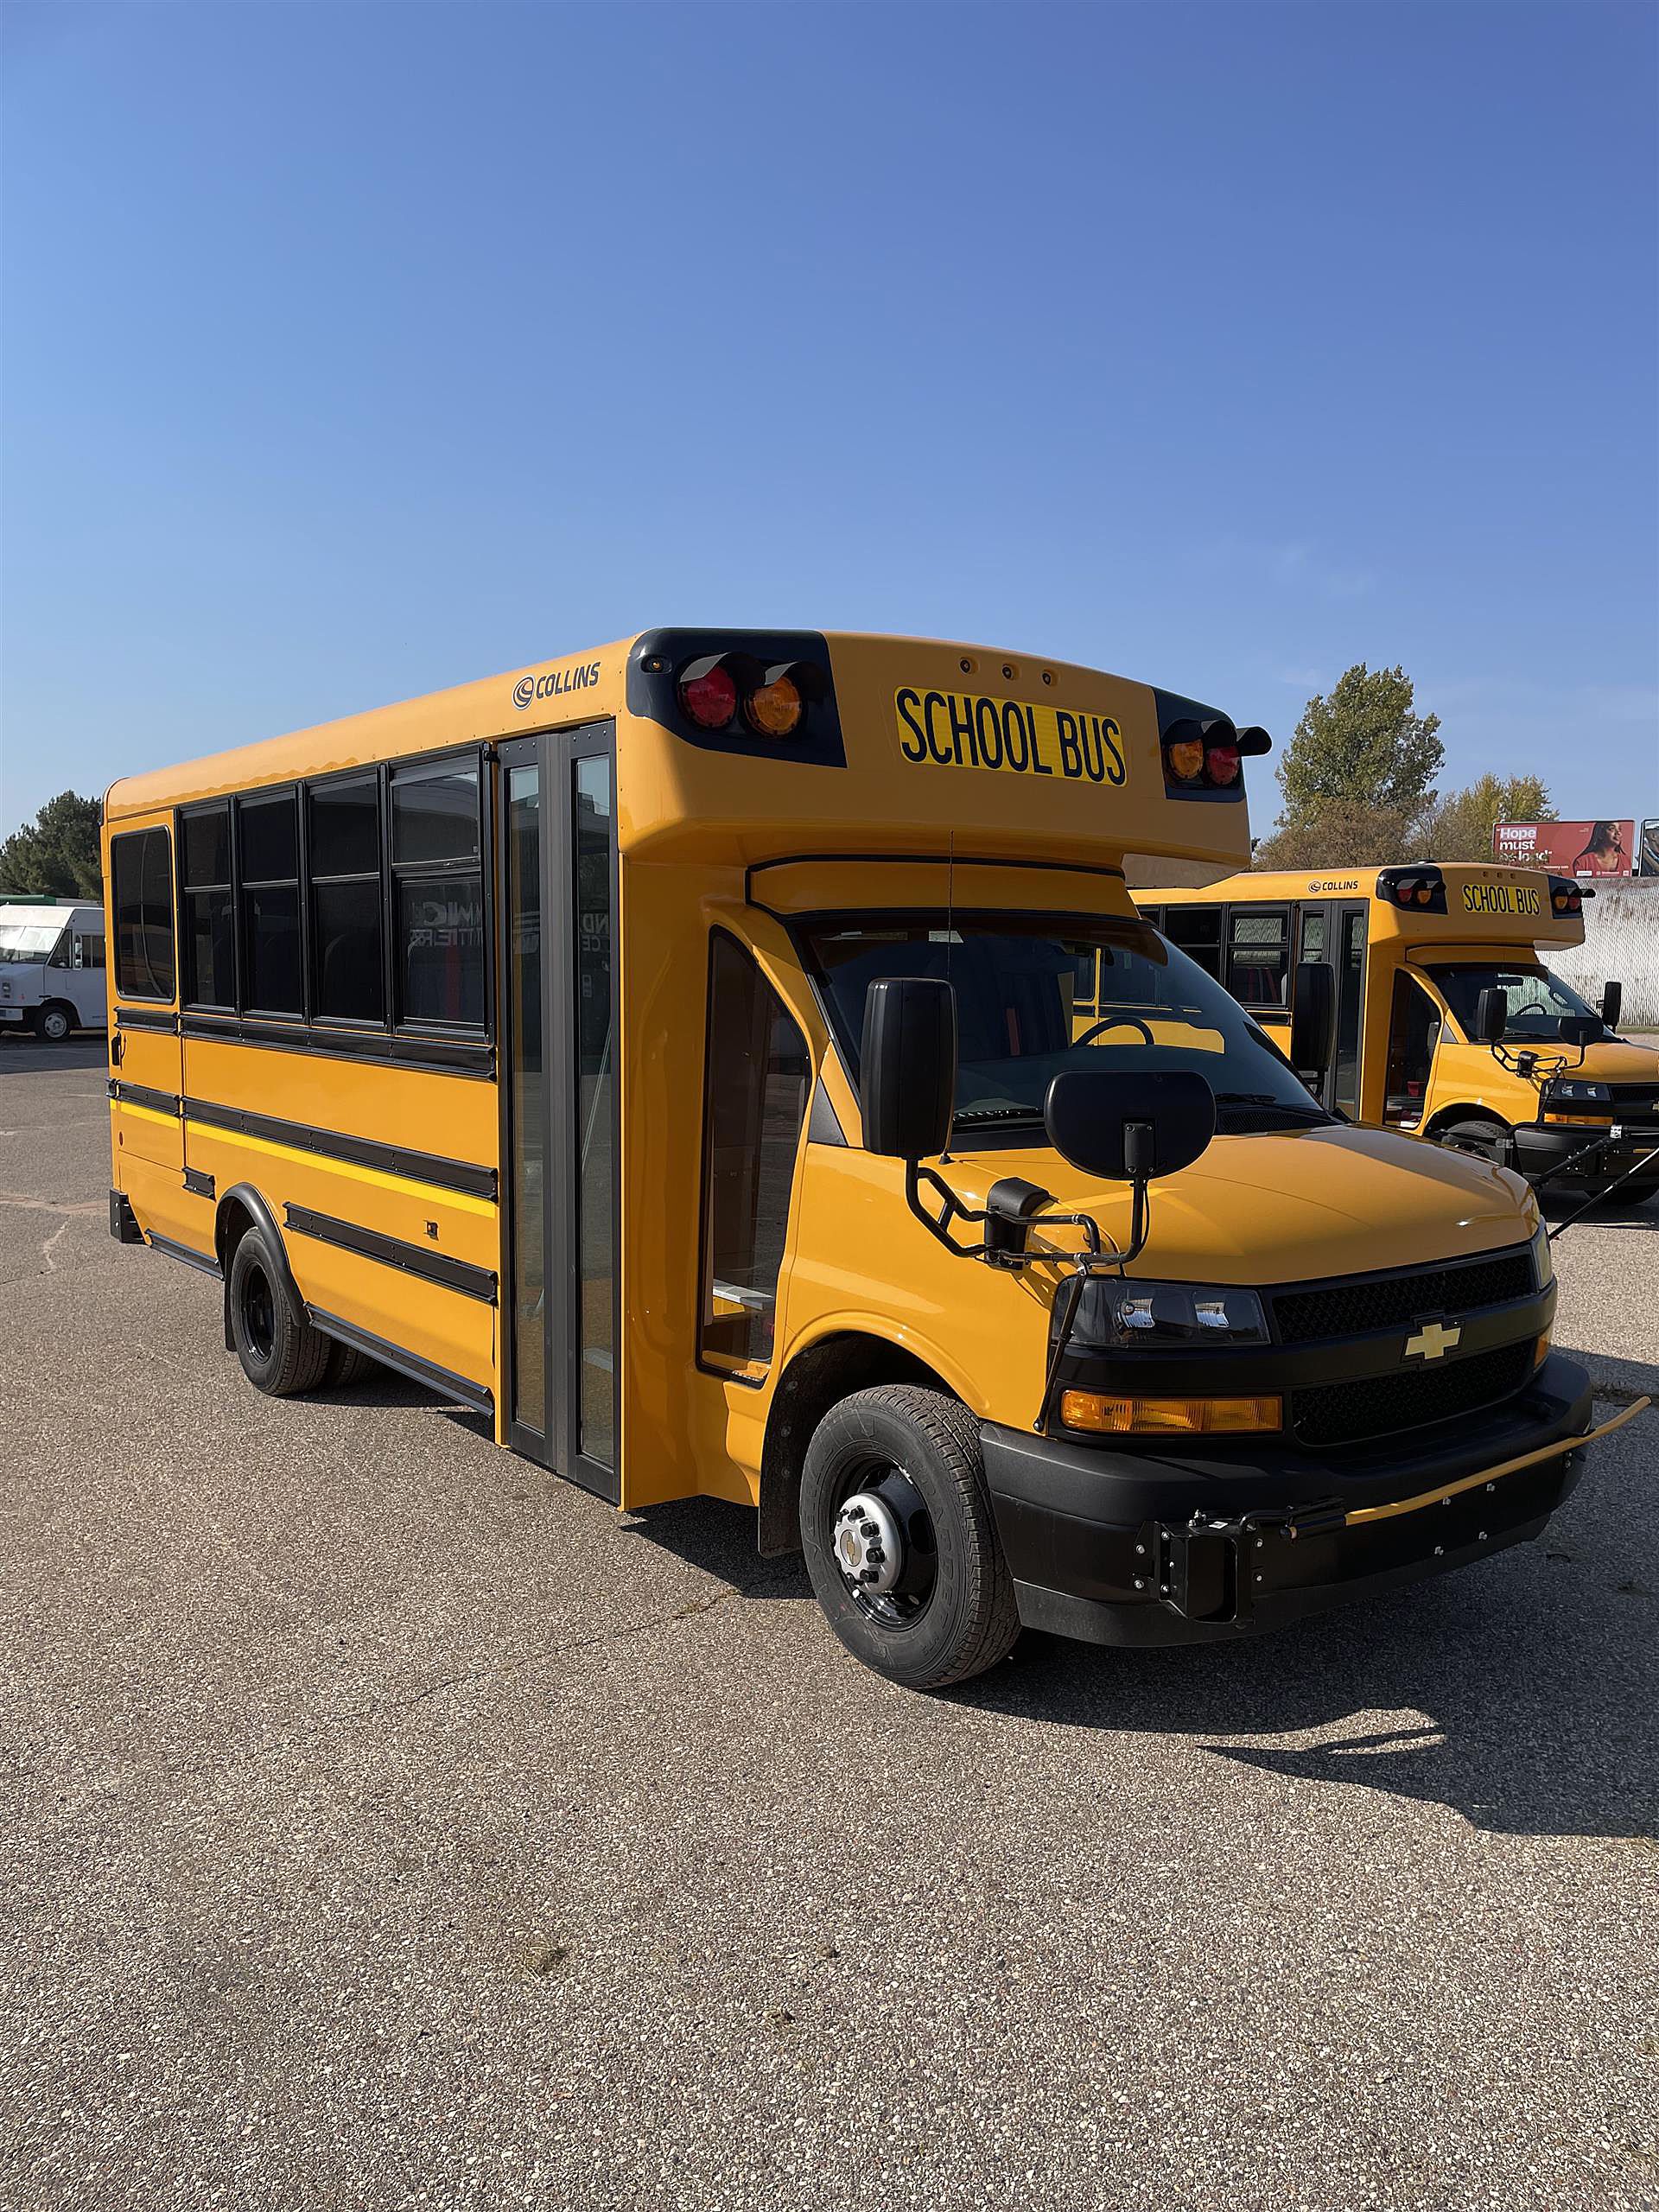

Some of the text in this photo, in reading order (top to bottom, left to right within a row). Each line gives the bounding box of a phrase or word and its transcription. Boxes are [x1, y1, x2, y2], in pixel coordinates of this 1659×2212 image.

[536, 661, 601, 699] COLLINS
[896, 688, 1126, 786] SCHOOL BUS
[1499, 839, 1535, 850] must
[1322, 880, 1358, 891] COLLINS
[1463, 885, 1540, 915] SCHOOL BUS
